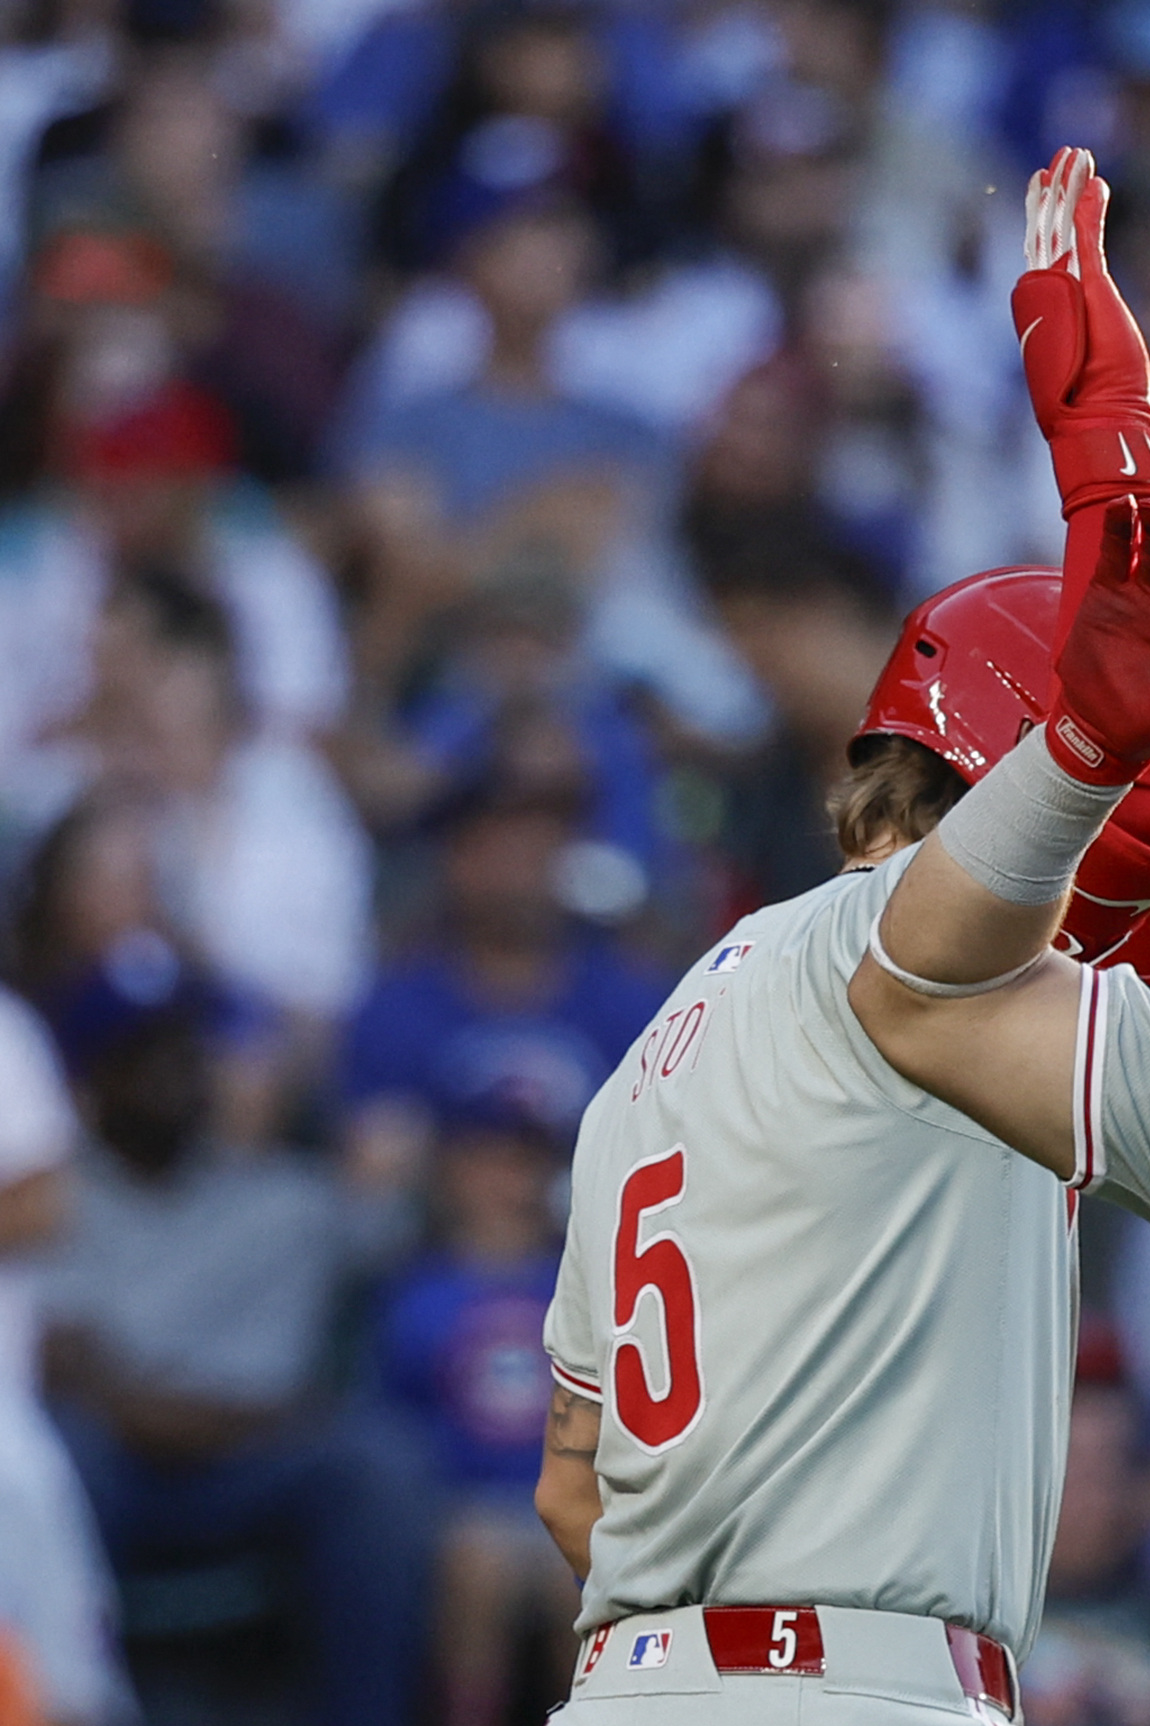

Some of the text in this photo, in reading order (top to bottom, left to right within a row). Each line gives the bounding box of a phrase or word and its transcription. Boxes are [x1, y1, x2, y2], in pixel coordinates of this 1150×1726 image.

[630, 988, 727, 1102] STO
[611, 1142, 705, 1456] 5
[768, 1610, 798, 1668] 5
